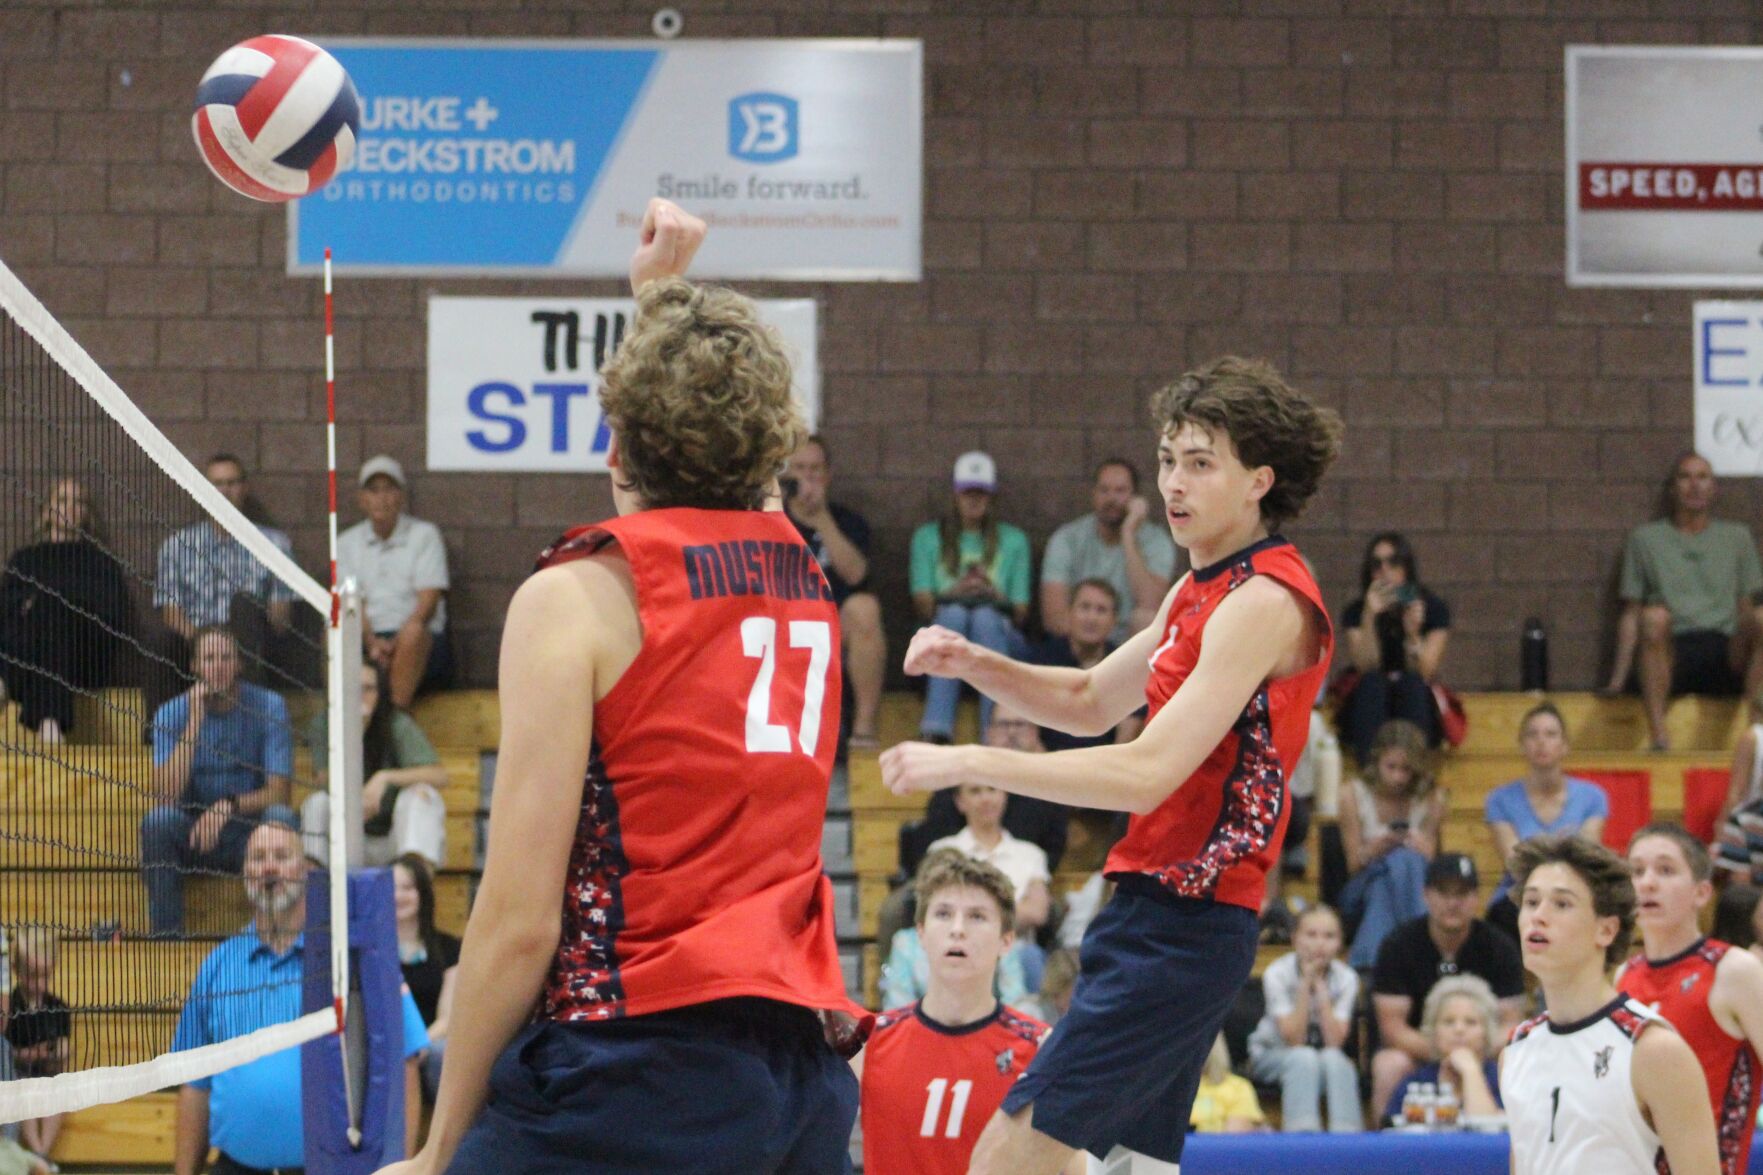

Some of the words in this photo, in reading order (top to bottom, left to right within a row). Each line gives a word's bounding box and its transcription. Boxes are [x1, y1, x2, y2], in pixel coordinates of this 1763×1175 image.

[359, 97, 462, 131] URKE
[323, 180, 577, 202] ORTHODONTICS
[656, 173, 738, 200] Smile
[747, 173, 870, 200] forward.
[740, 616, 831, 757] 27
[920, 1077, 973, 1138] 11
[1548, 1086, 1561, 1142] 1
